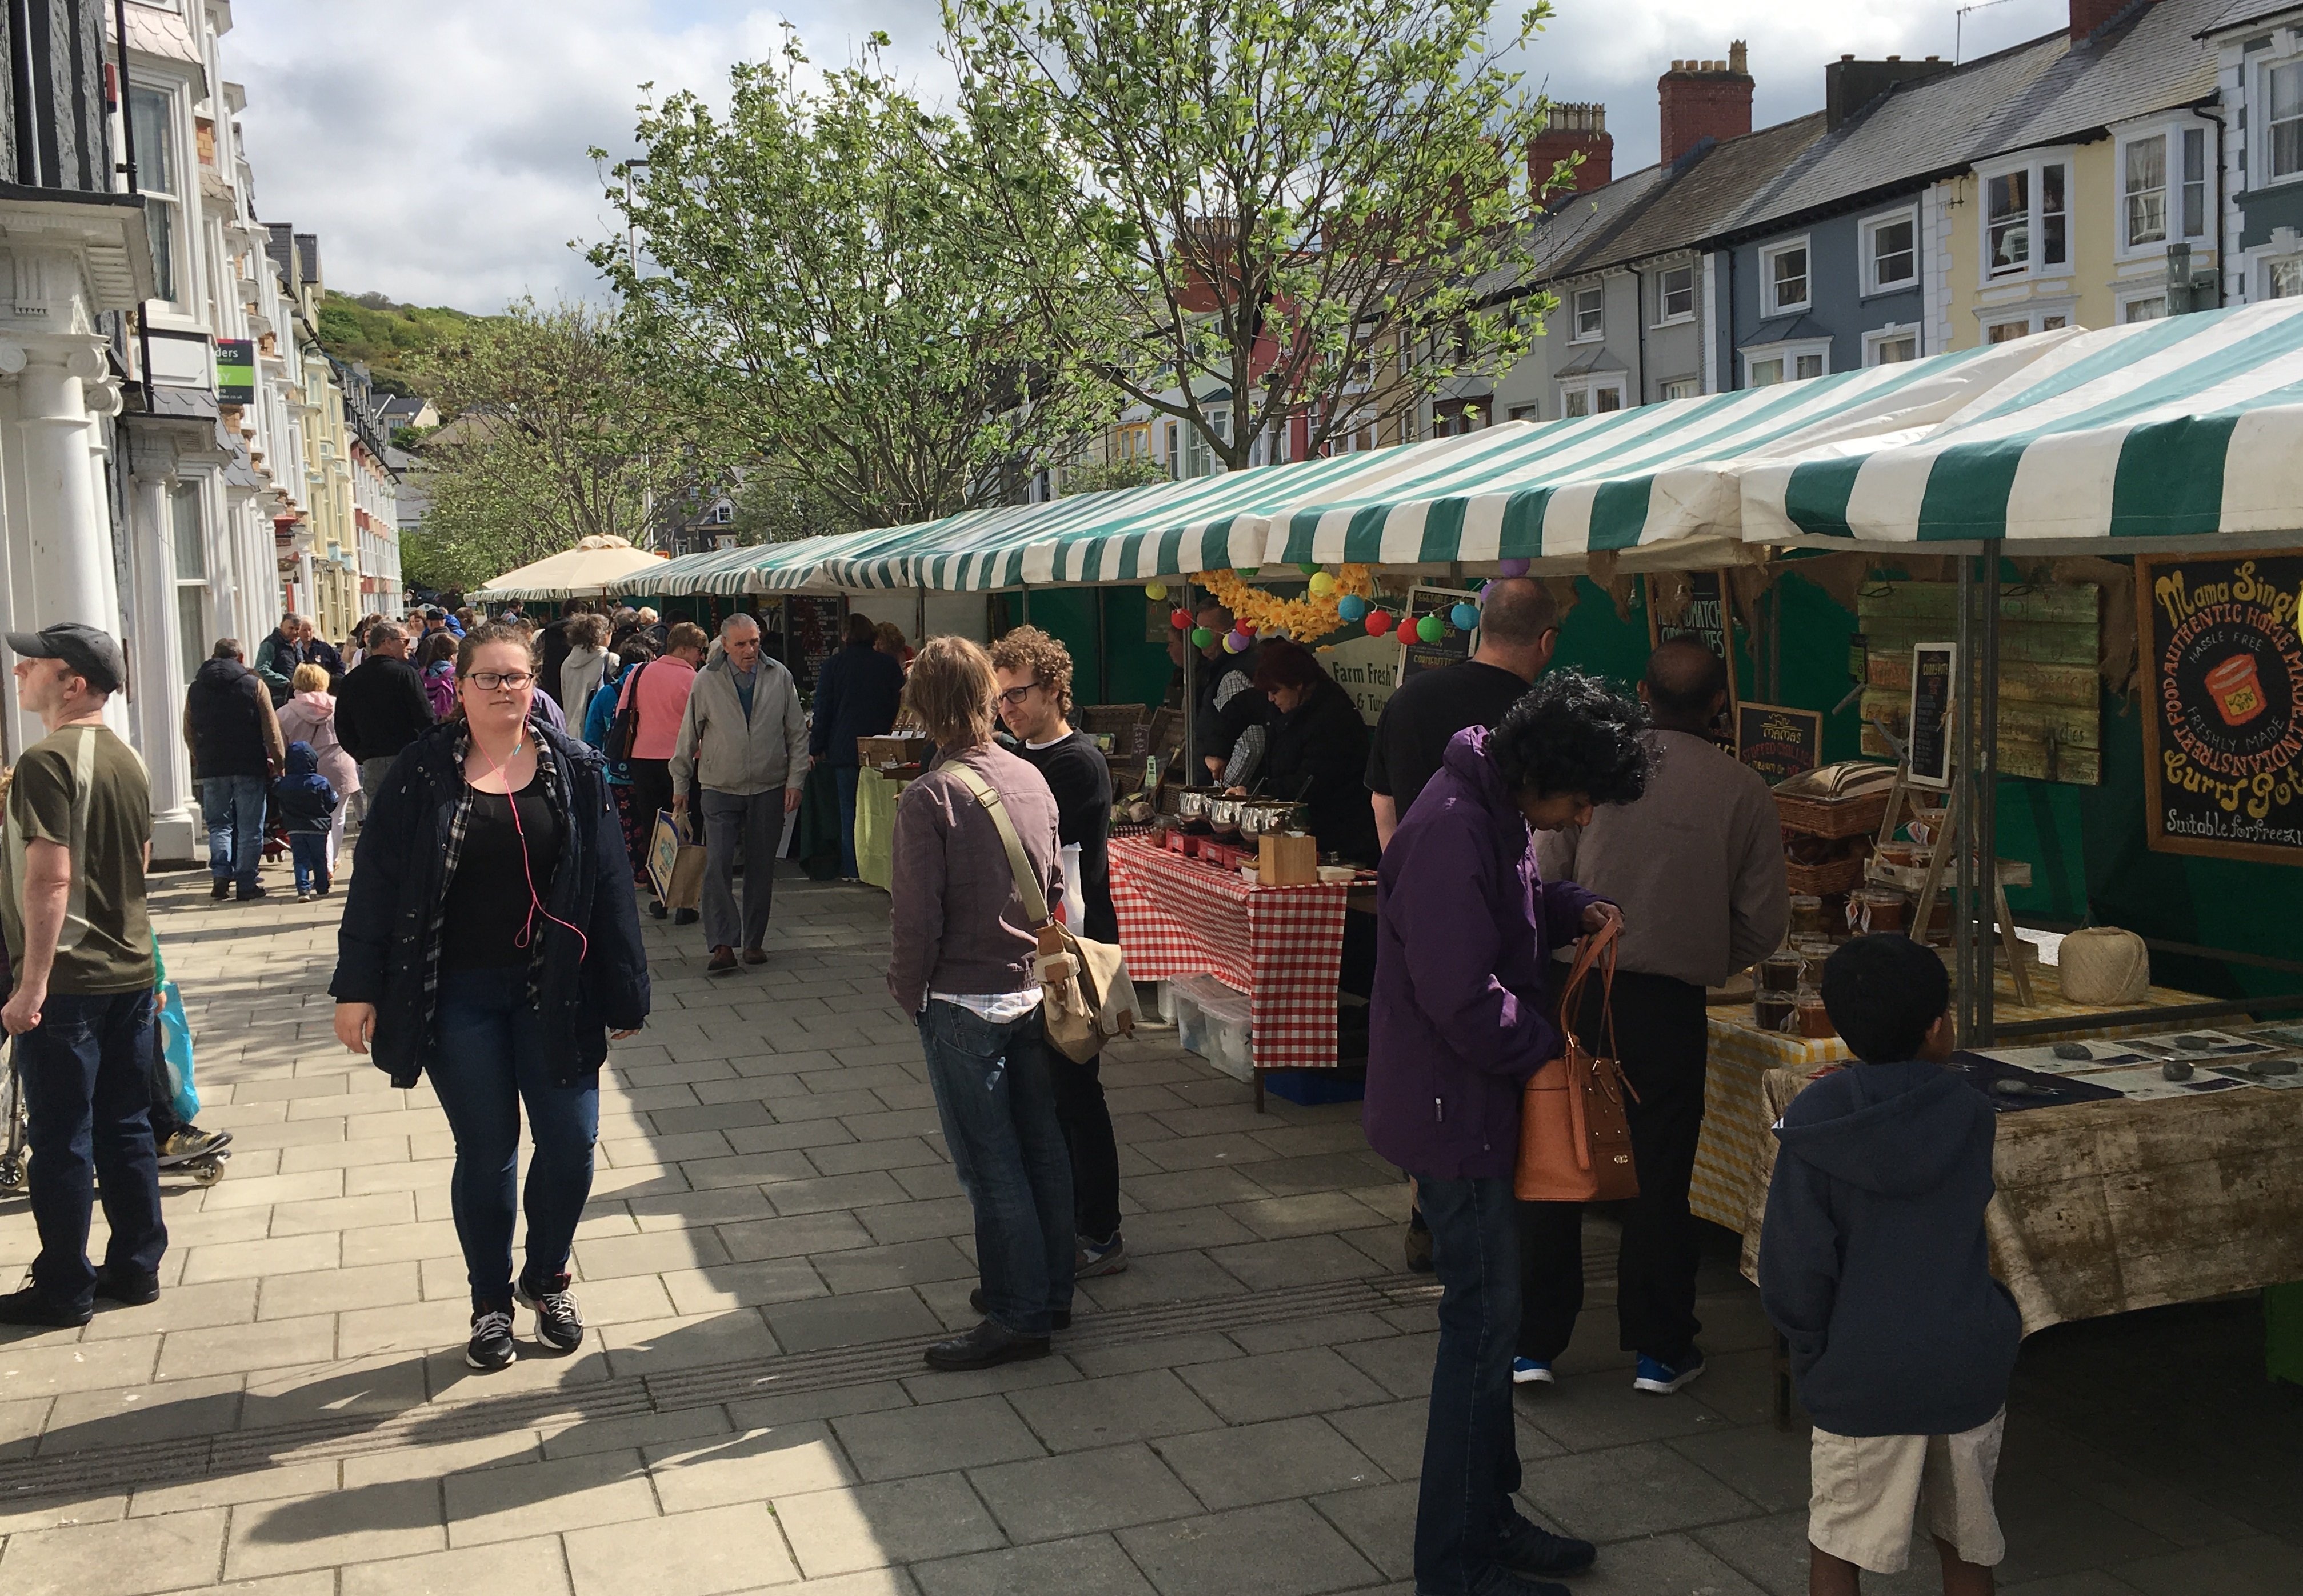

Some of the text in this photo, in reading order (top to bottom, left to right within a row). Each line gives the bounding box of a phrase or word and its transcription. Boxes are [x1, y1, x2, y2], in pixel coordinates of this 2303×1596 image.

[2155, 570, 2229, 629] Mama
[2164, 603, 2242, 677] AUTHENTIC
[2189, 631, 2263, 663] HASSLE FREE
[2245, 606, 2296, 652] HOME
[1332, 661, 1364, 683] Farm
[1367, 663, 1390, 686] Fresh
[1357, 693, 1365, 710] &
[2163, 677, 2185, 726] FOOD
[1763, 727, 1801, 743] MAMAS
[2187, 706, 2285, 752] FRESHLY MADE
[2164, 750, 2303, 818] Curry Pot
[2166, 809, 2228, 837] Suitable
[2253, 819, 2303, 845] freezi
